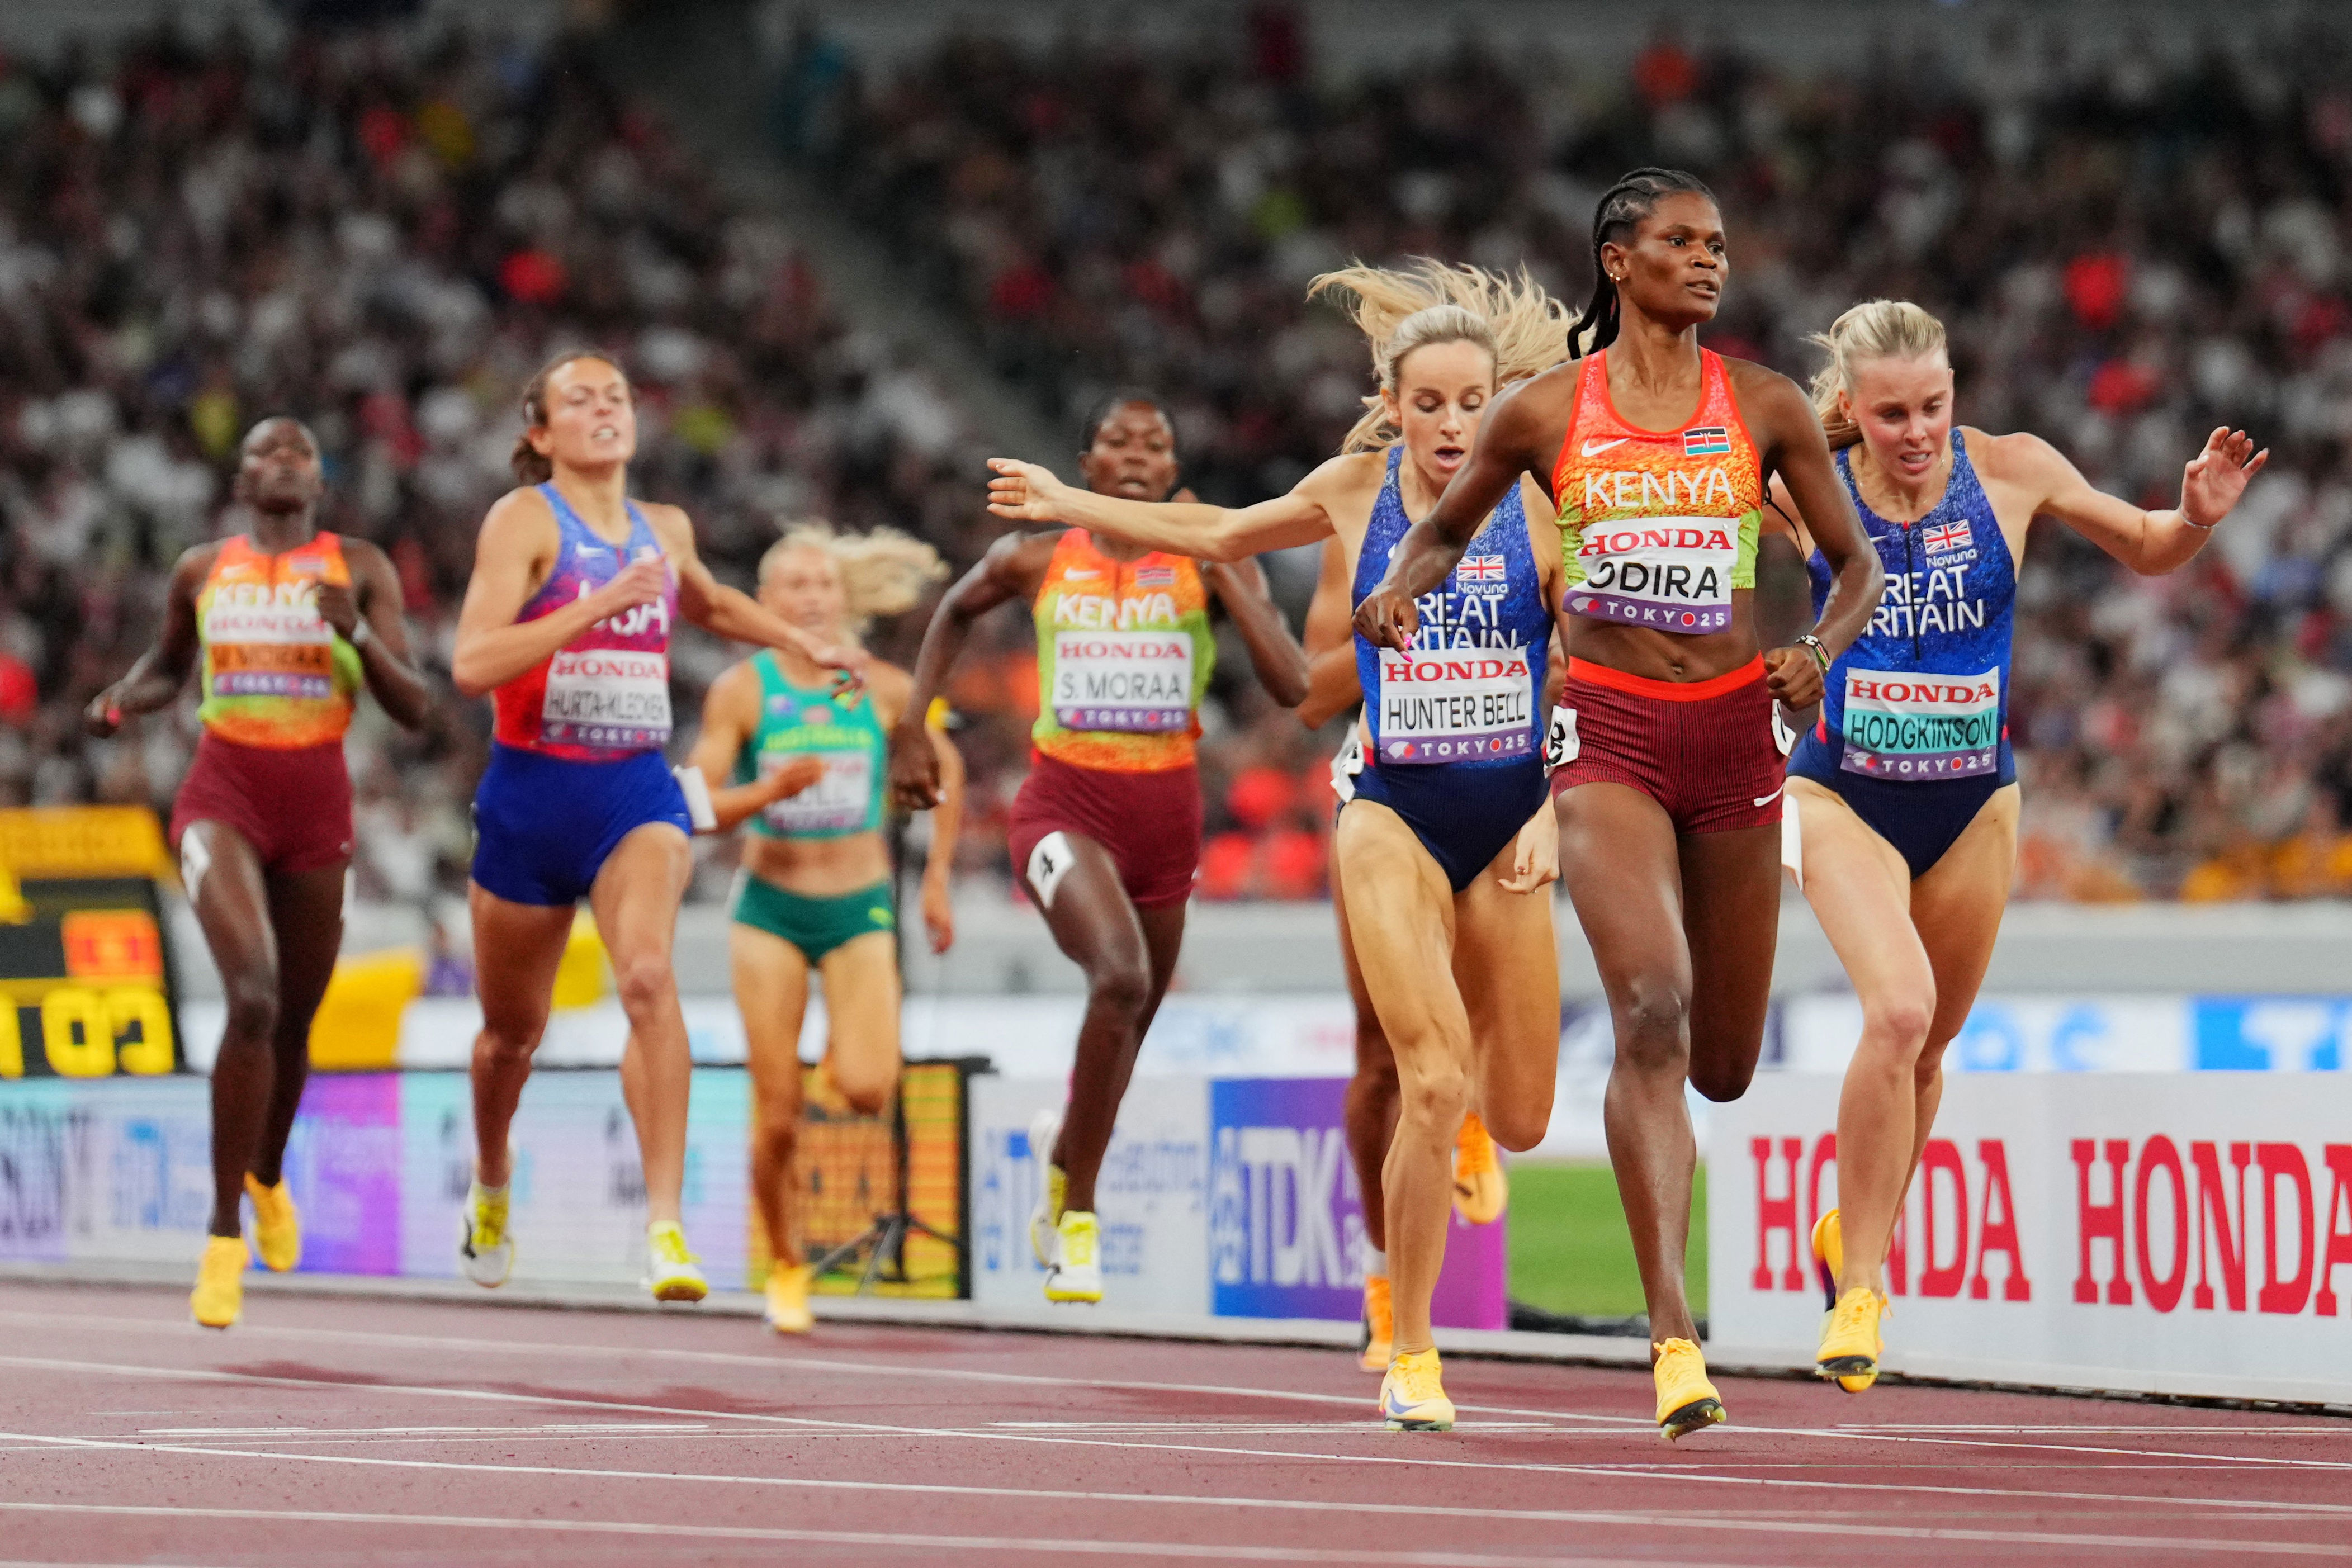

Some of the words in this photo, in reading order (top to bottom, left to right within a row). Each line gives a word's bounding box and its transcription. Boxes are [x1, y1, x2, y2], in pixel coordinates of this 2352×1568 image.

[1585, 468, 1734, 509] KENYA
[1579, 528, 1733, 556] HONDA
[1927, 548, 1977, 568] Novuna
[1456, 582, 1508, 594] Novuna
[1587, 562, 1719, 599] ODIRA
[1880, 564, 1969, 604] REAT
[1054, 593, 1176, 629] KENYA
[1413, 592, 1505, 627] REAT
[1861, 599, 1984, 638] RITAIN
[1059, 642, 1186, 659] HONDA
[555, 660, 664, 678] HONDA
[1062, 672, 1078, 700] S.
[1086, 672, 1183, 700] MORAA
[1384, 660, 1528, 682] HONDA
[1849, 678, 1995, 704] HONDA
[1388, 695, 1476, 730] HUNTER
[1484, 691, 1526, 726] BELL
[1851, 712, 1993, 749] HODGKINSON
[1239, 1126, 1342, 1288] TDK
[2070, 1133, 2352, 1316] HONDA
